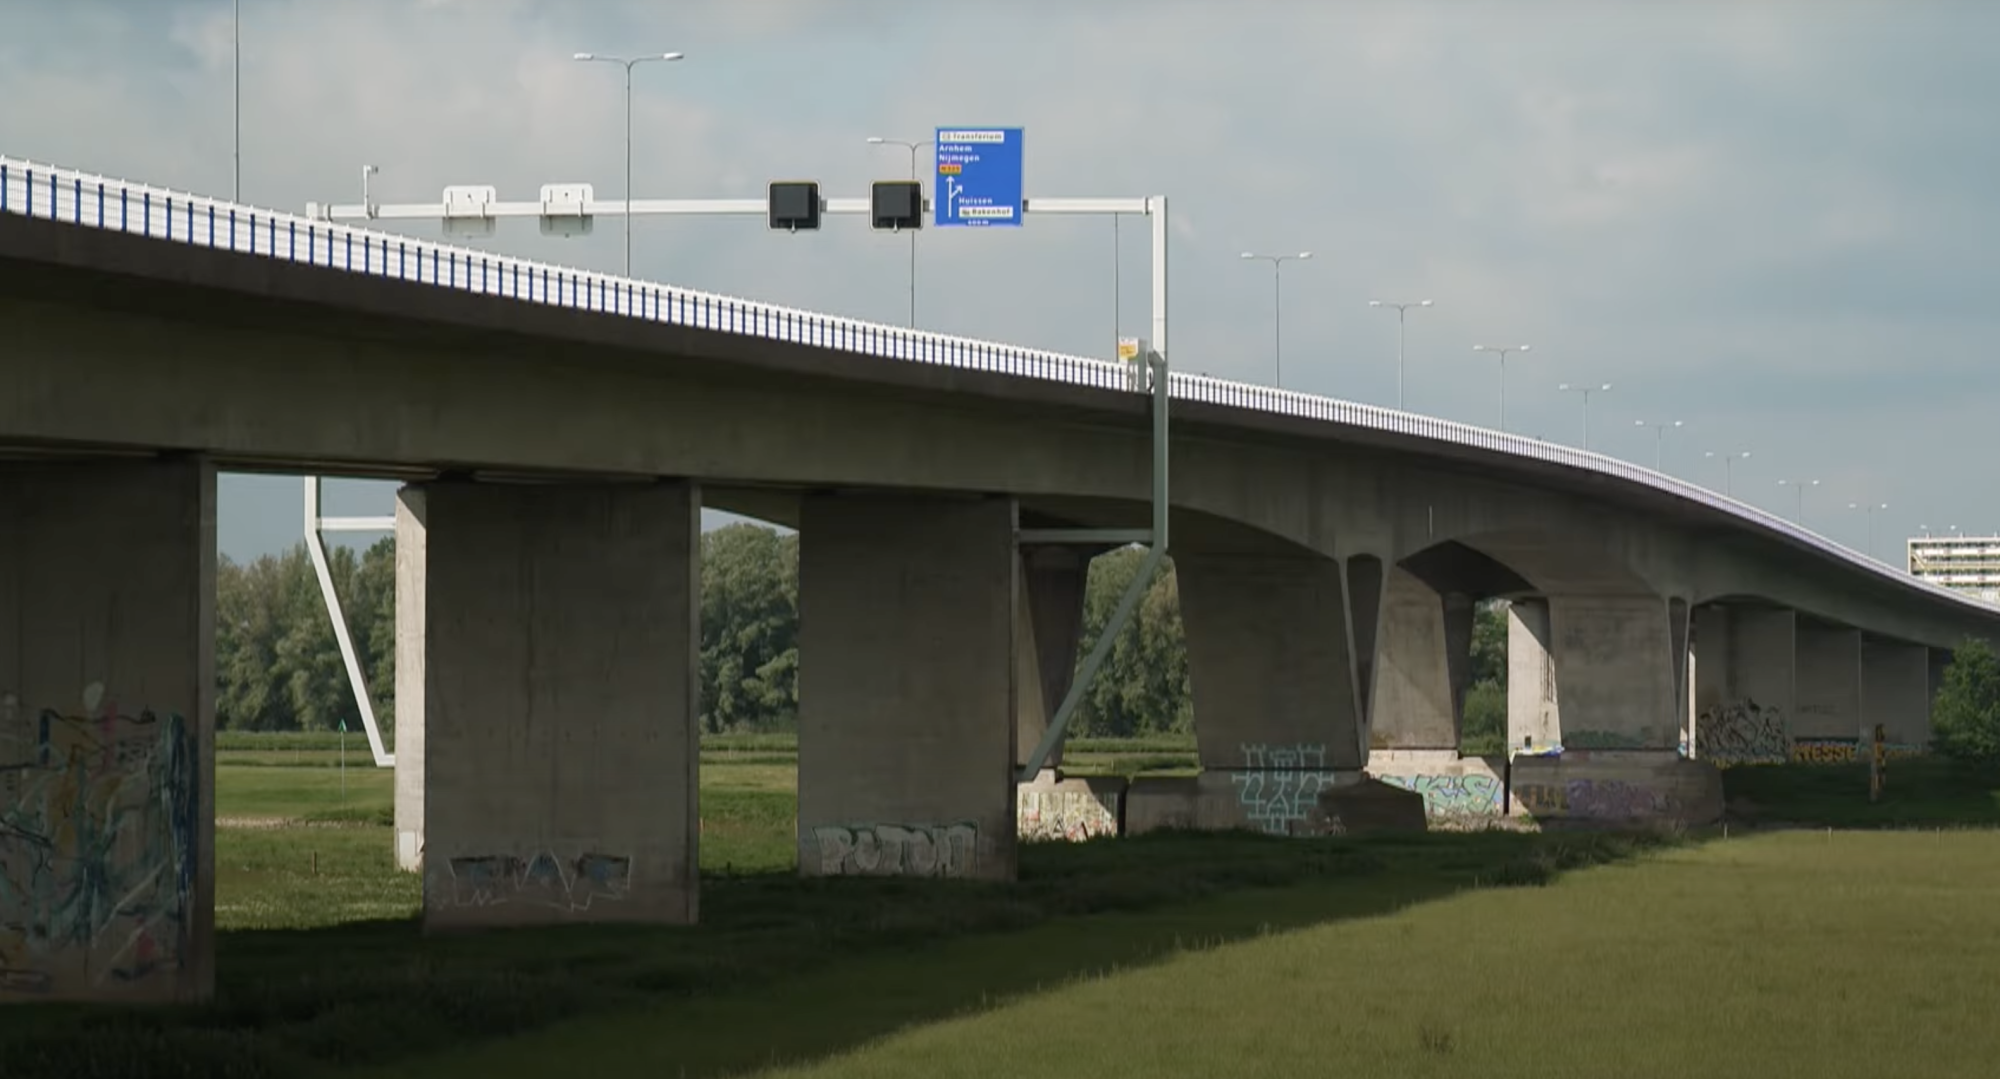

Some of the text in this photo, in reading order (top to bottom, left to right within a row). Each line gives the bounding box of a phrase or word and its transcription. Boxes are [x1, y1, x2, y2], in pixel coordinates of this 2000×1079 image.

[953, 132, 1002, 140] Transferium
[939, 144, 972, 152] Arnhem
[939, 154, 980, 164] Nijmegen
[959, 197, 993, 205] Huissen
